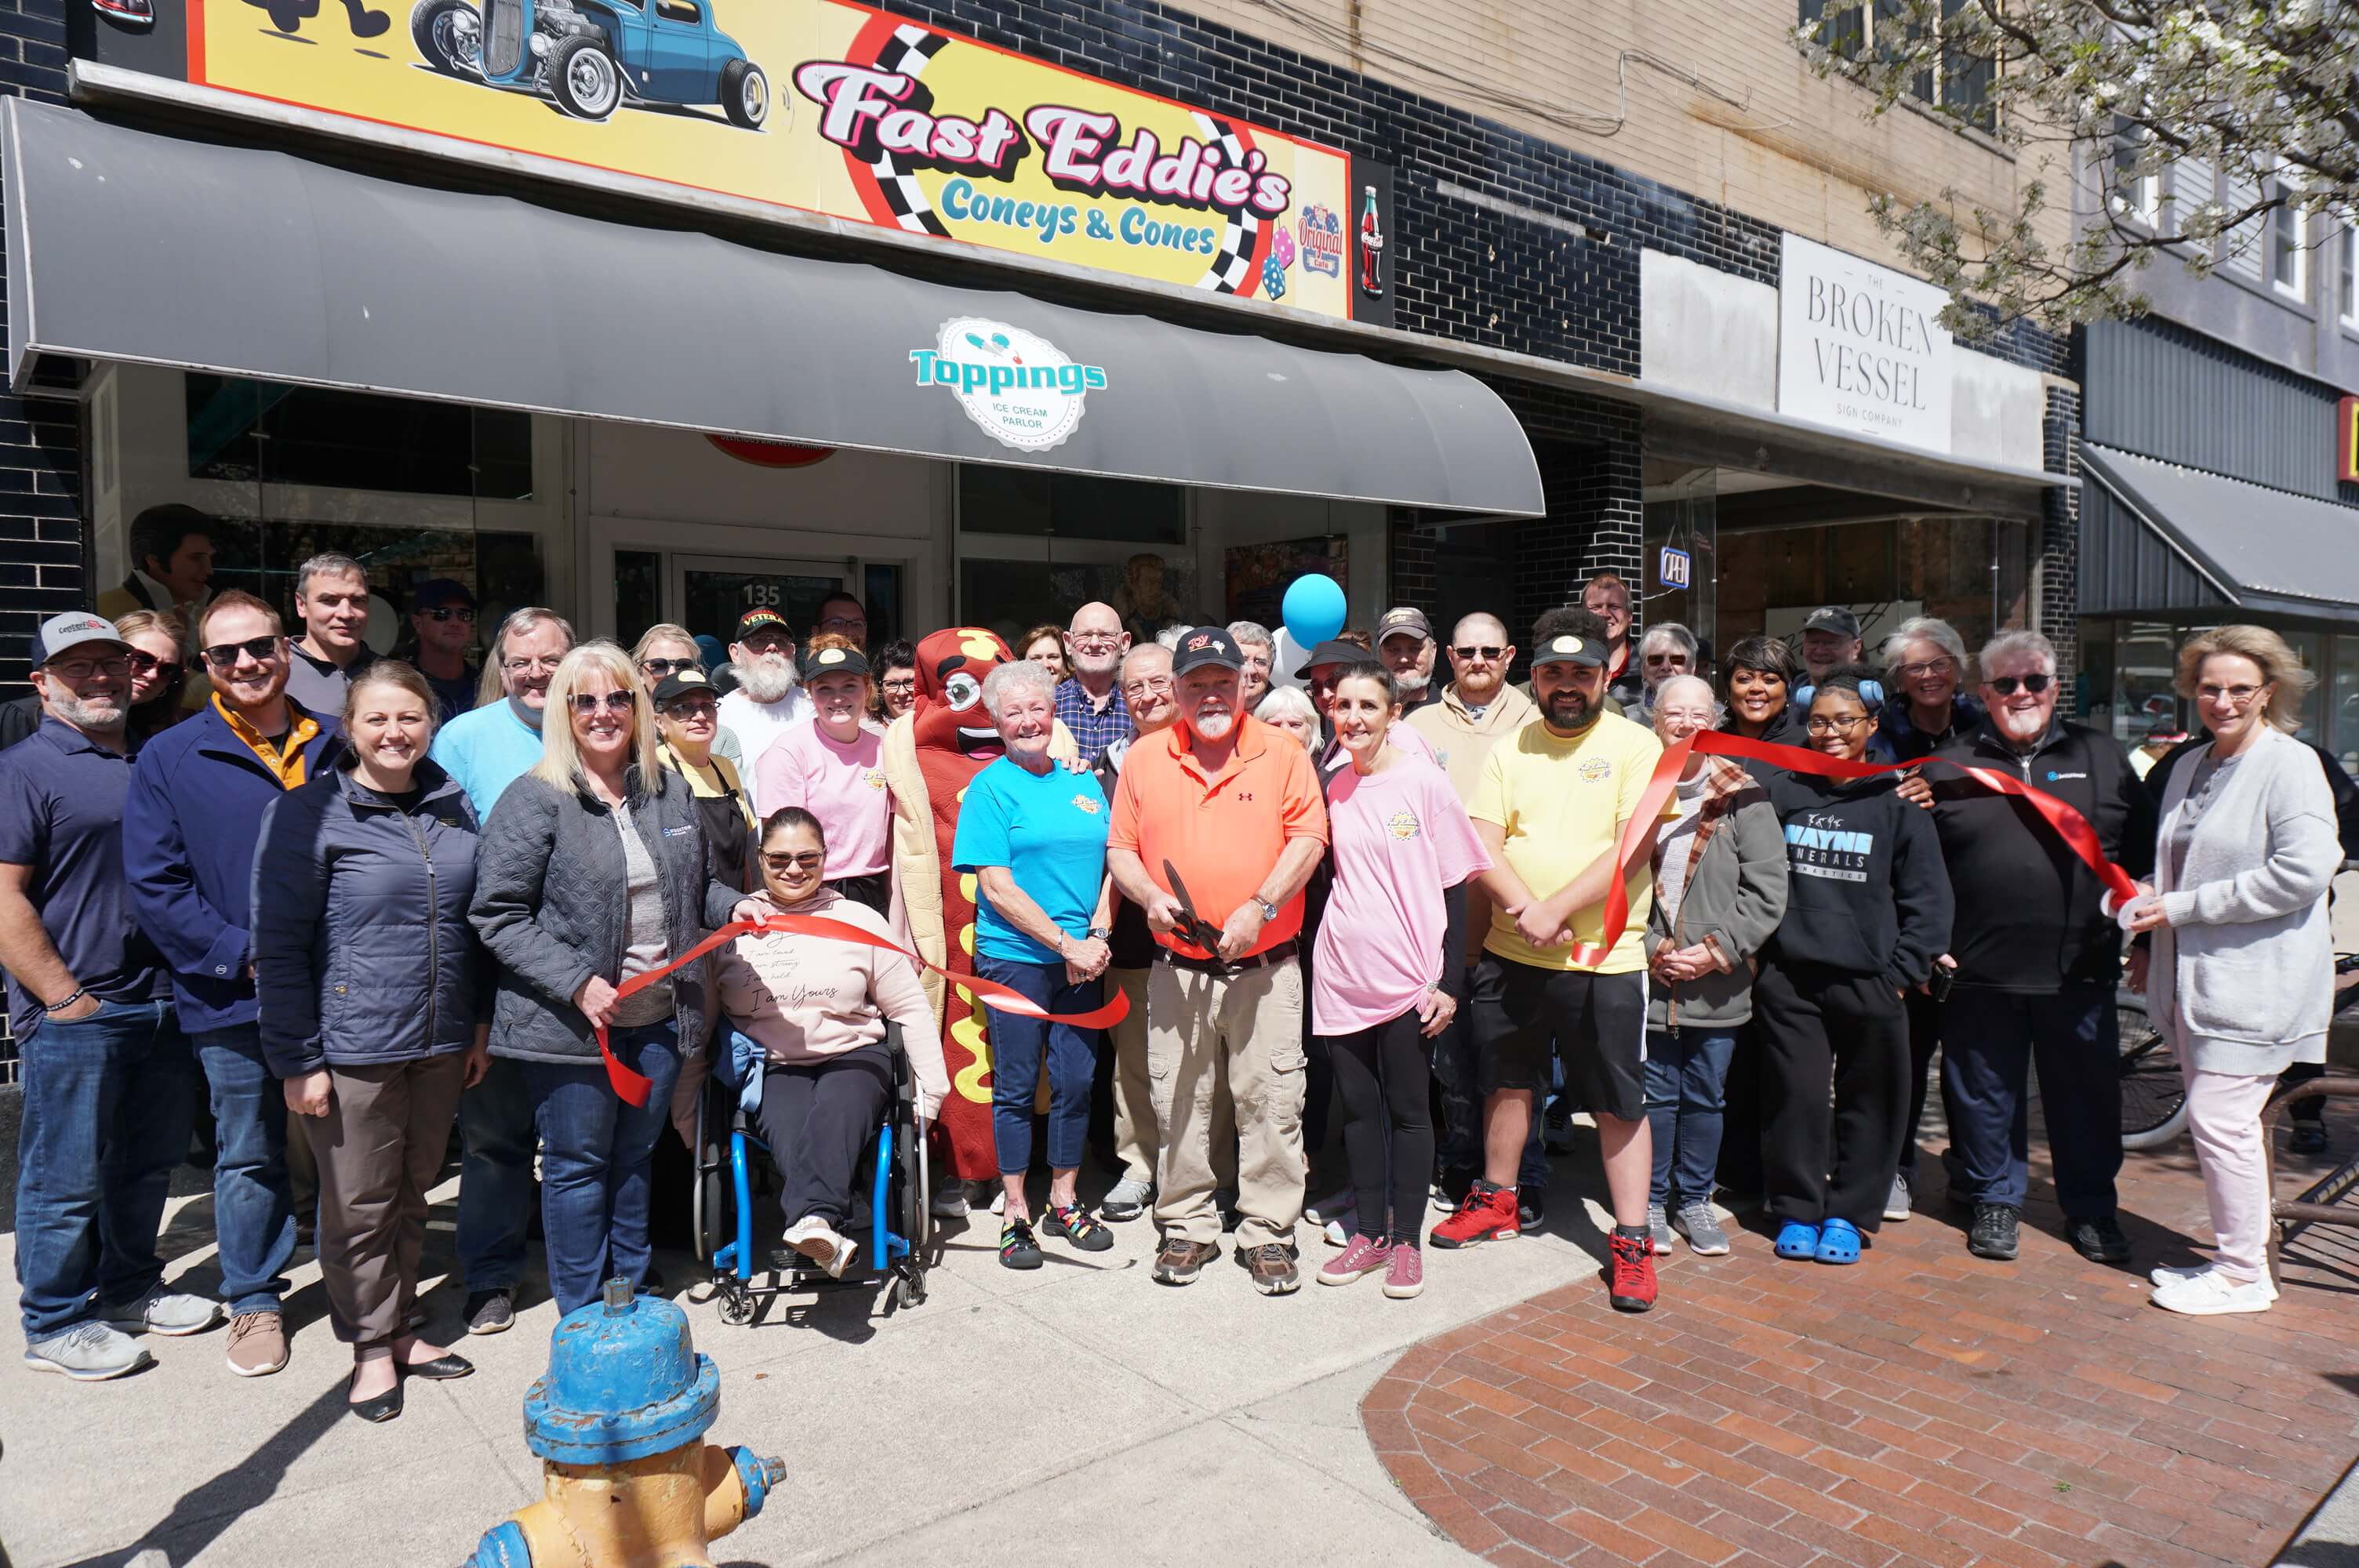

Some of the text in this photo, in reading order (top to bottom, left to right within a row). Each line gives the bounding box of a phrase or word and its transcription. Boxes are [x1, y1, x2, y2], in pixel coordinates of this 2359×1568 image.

[795, 61, 1292, 212] Fast Eddie's
[940, 177, 1216, 255] Coneys & Cones
[1299, 216, 1343, 259] Original
[1867, 274, 1884, 289] THE
[1808, 276, 1934, 357] BROKEN
[910, 350, 1107, 396] Toppings
[1815, 337, 1926, 410] VESSEL
[993, 402, 1048, 418] ICE CREAM
[1002, 416, 1043, 429] PARLOR
[1837, 403, 1903, 427] SIGN COMPANY
[1663, 552, 1689, 583] OPEN
[743, 583, 780, 605] 135
[1796, 847, 1864, 867] NERALS
[771, 959, 800, 971] strong
[751, 984, 838, 1013] I am Yours
